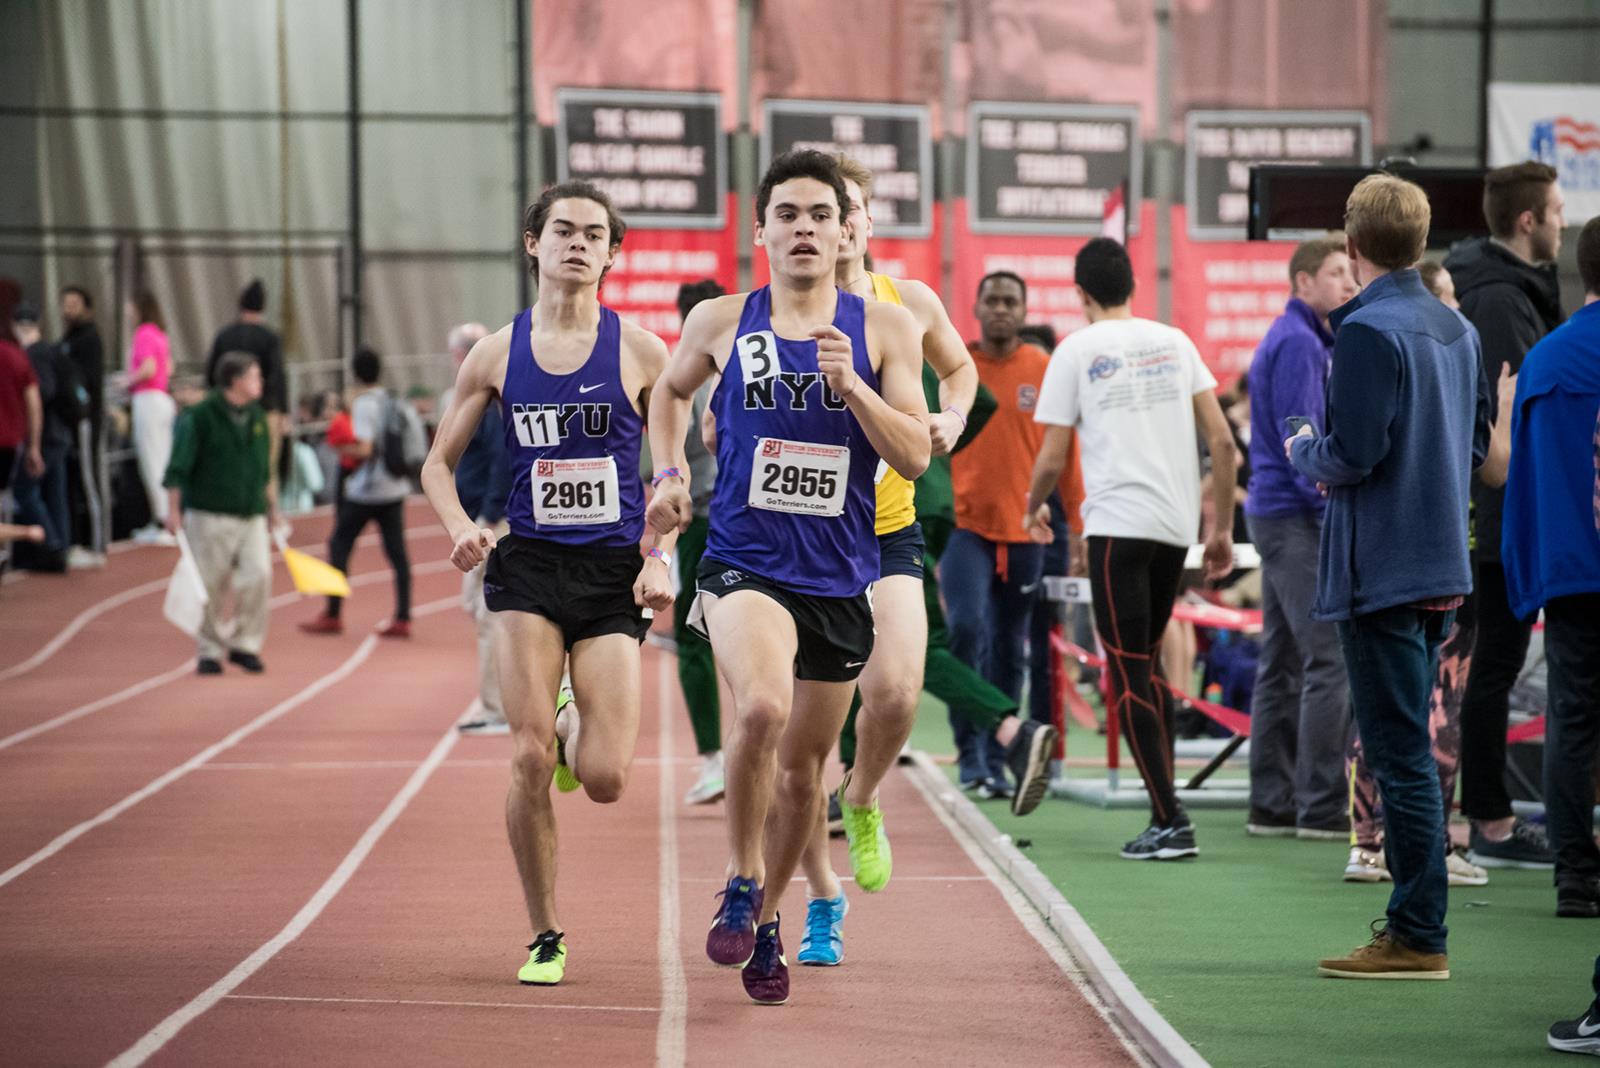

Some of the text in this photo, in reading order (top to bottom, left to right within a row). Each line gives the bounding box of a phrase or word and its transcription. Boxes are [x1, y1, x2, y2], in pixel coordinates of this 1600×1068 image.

[746, 334, 771, 378] 3
[512, 403, 612, 438] YU
[521, 412, 549, 445] 11
[541, 480, 606, 509] 2961
[762, 463, 838, 499] 2955
[547, 512, 605, 520] GoTerriers.com
[766, 498, 827, 510] GoTerriers.com
